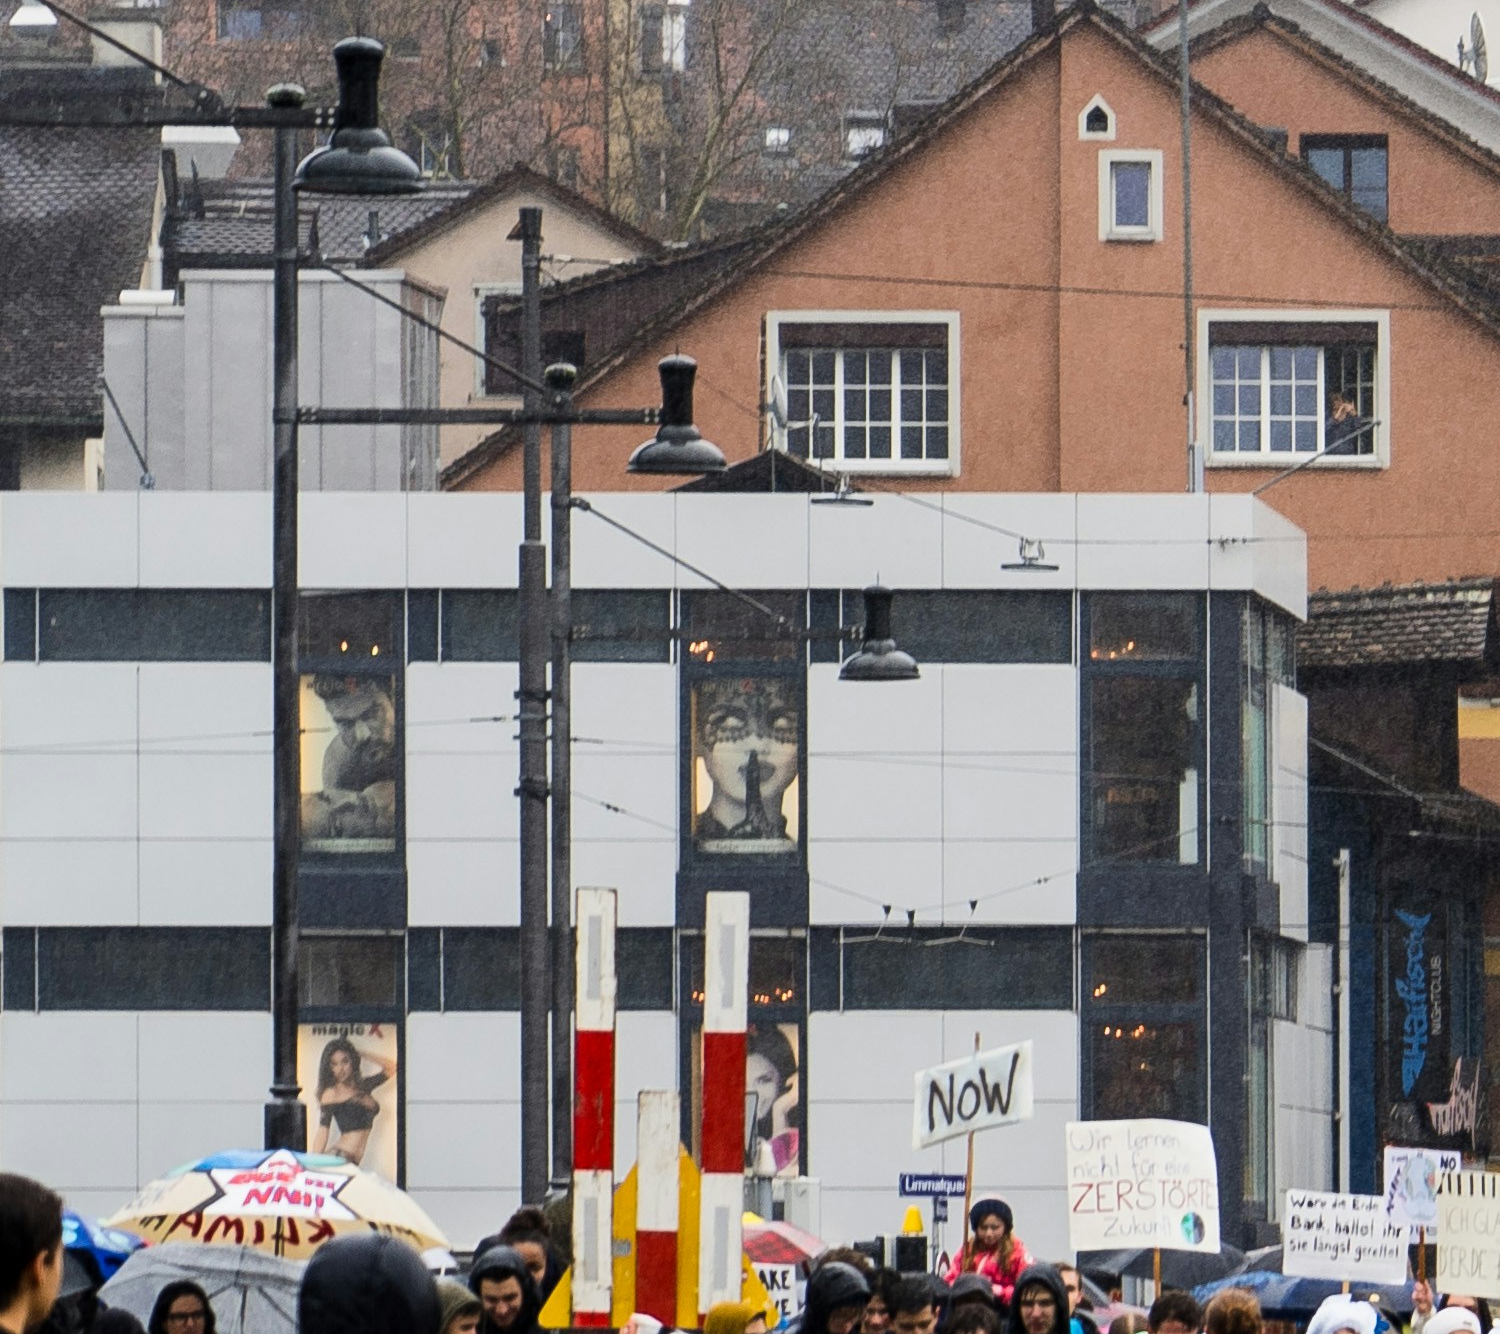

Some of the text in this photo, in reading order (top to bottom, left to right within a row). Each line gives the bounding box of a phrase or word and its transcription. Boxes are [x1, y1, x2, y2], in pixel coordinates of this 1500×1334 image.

[928, 1052, 1020, 1131] NOW
[1440, 1155, 1457, 1170] NO
[1071, 1177, 1217, 1216] ZERSTÖRTE
